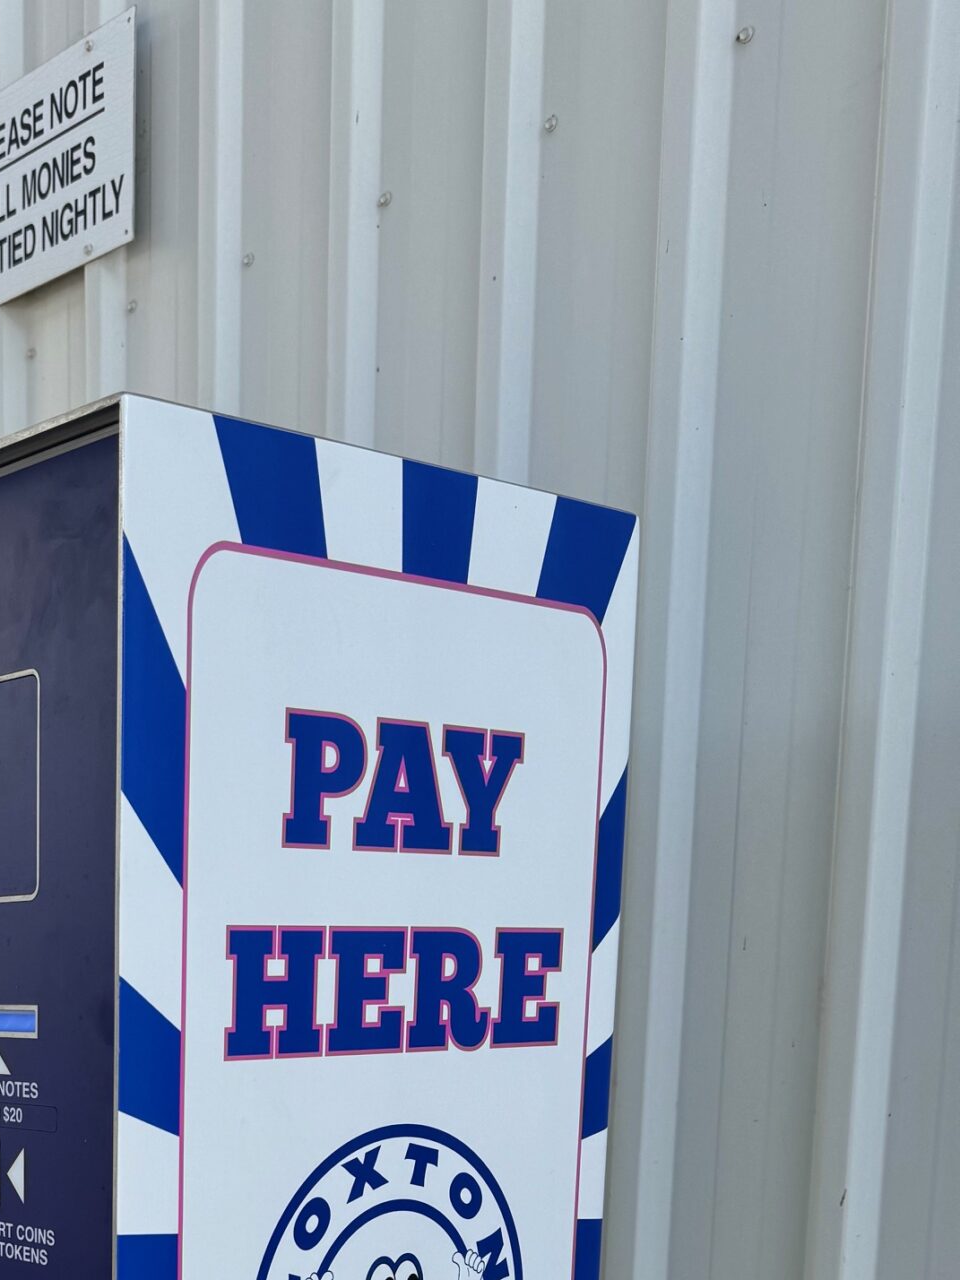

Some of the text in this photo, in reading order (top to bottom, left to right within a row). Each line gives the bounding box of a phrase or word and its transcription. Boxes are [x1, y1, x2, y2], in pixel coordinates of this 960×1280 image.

[50, 61, 105, 130] NOTE
[21, 135, 97, 211] MONIES
[41, 174, 125, 252] NIGHTLY
[281, 706, 526, 858] PAY
[223, 924, 565, 1062] HERE
[3, 1105, 23, 1123] $20
[16, 1224, 56, 1247] COINS
